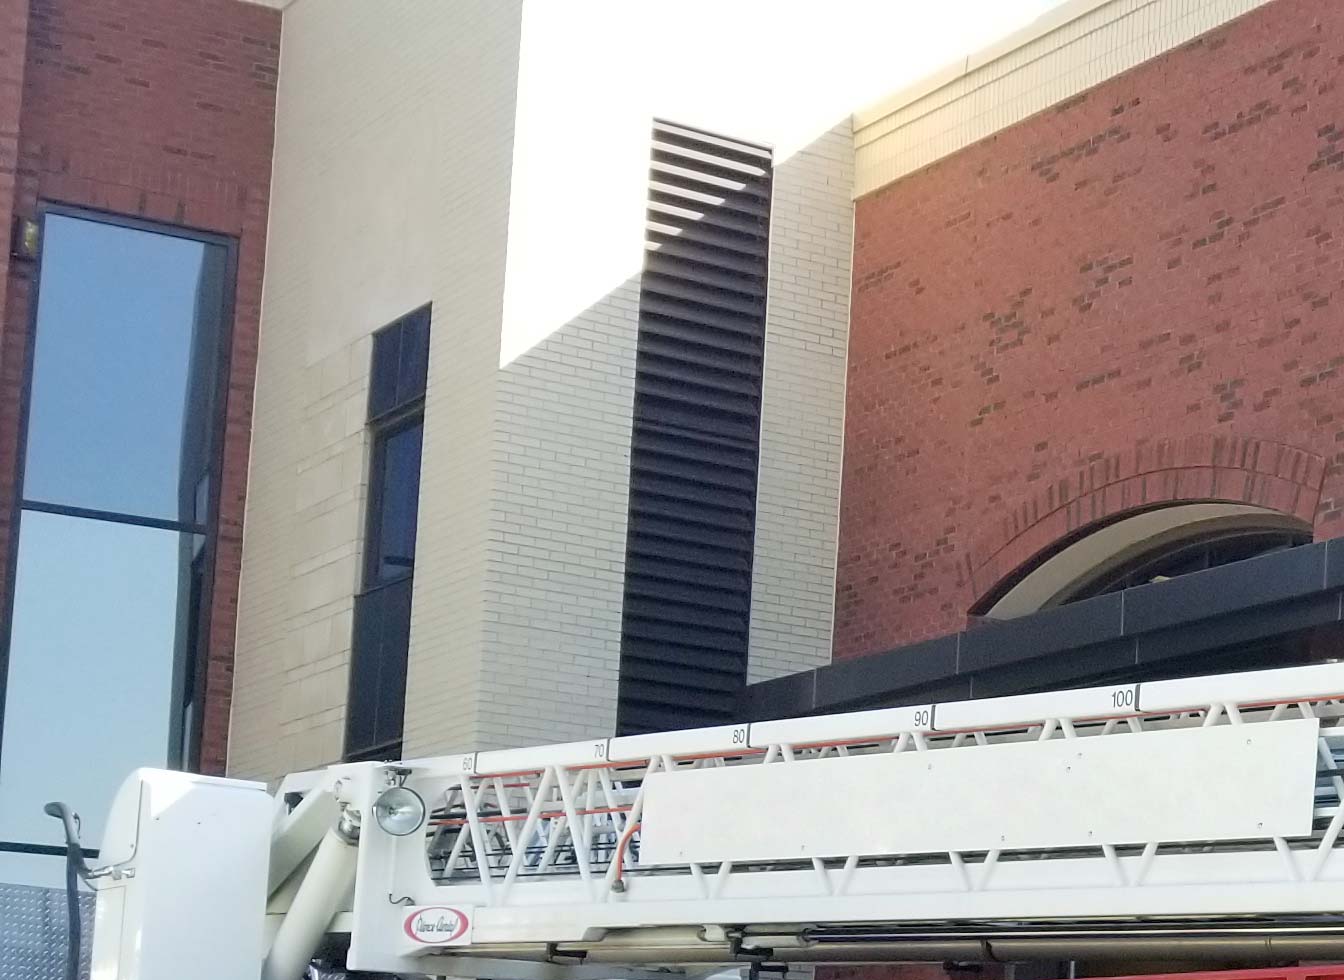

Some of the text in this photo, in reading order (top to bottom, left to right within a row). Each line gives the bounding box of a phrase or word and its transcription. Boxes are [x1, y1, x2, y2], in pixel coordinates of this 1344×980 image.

[1112, 690, 1133, 708] 100
[914, 710, 928, 727] 90
[732, 729, 745, 744] 80
[594, 744, 604, 758] 70
[462, 757, 473, 771] 60
